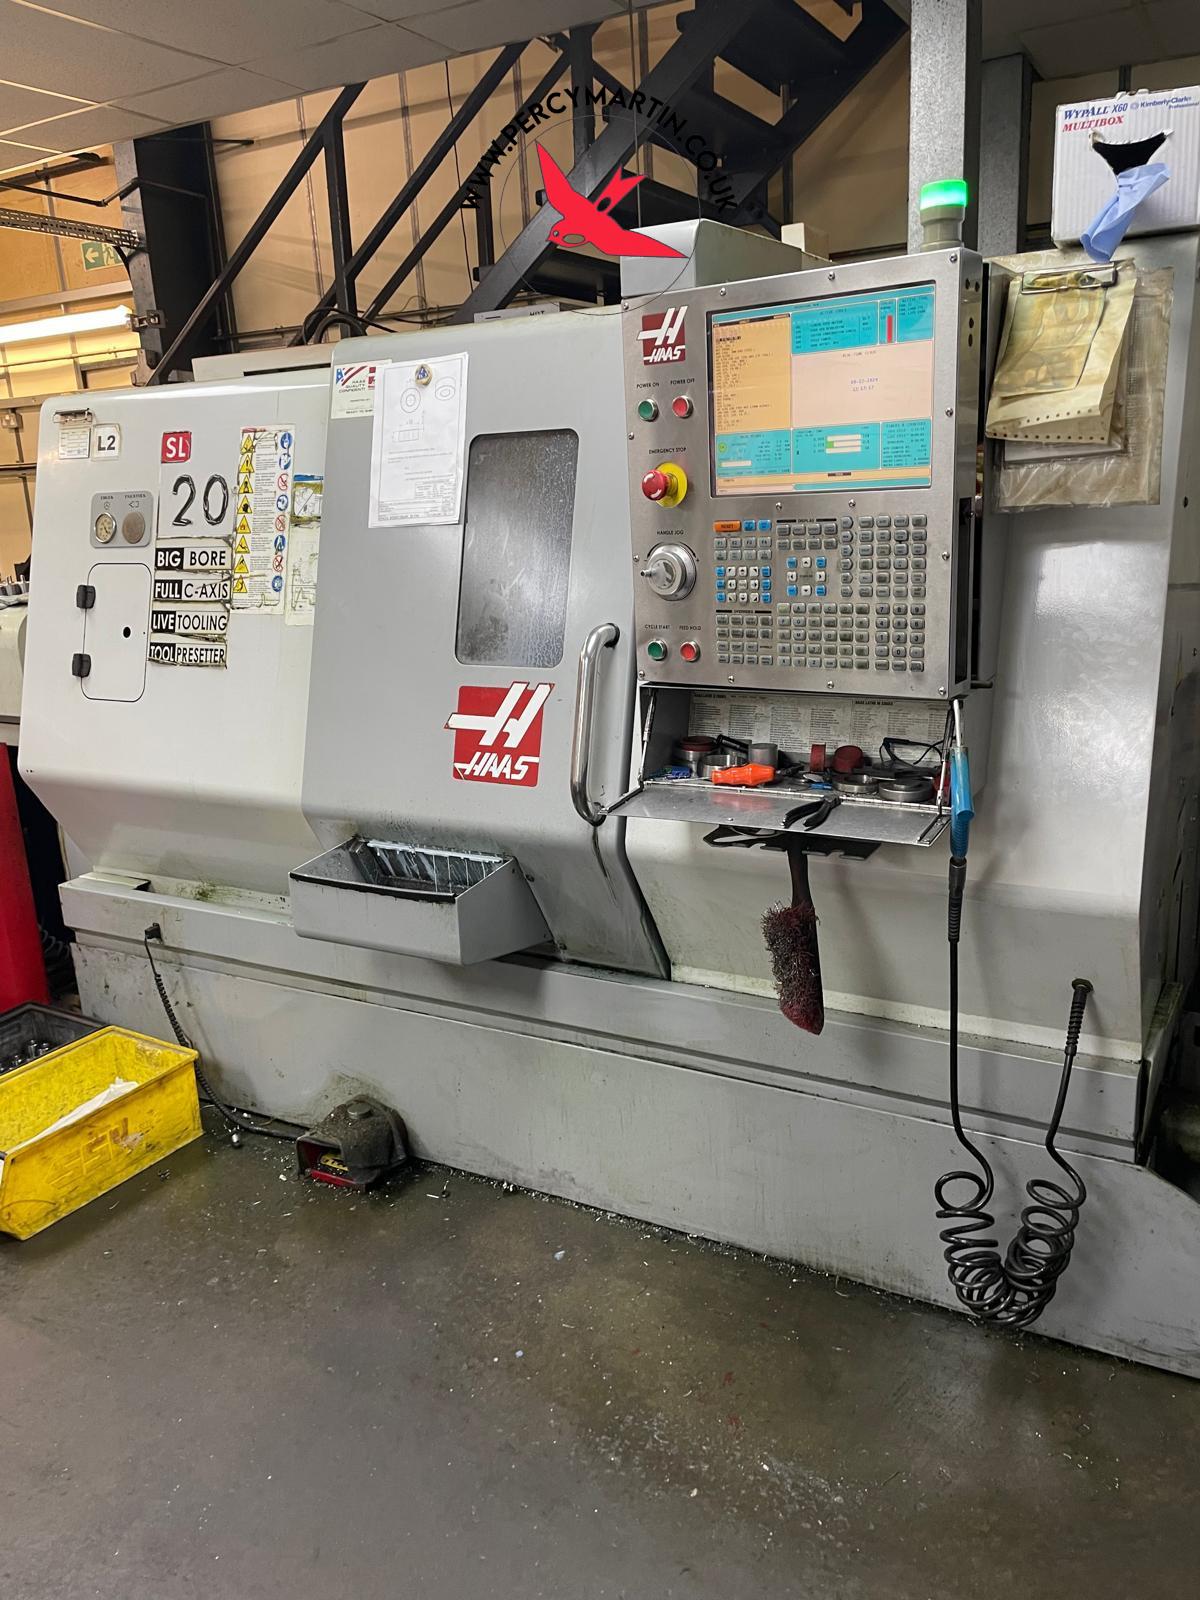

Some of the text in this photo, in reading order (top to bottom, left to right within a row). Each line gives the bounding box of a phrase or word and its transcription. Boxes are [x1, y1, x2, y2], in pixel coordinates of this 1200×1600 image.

[1111, 102, 1129, 115] X60
[1062, 115, 1124, 132] MULTIBOX
[642, 344, 686, 364] HAAS
[97, 434, 116, 452] L2
[165, 436, 187, 459] SL
[648, 447, 675, 455] EMERGENCY
[172, 474, 230, 527] 20
[157, 550, 226, 567] BIG BORE
[154, 582, 229, 600] FULL C-AXIS
[152, 613, 228, 631] LIVE TOOLING
[150, 644, 225, 664] TOOL PRESETTER
[453, 751, 540, 780] HAAS
